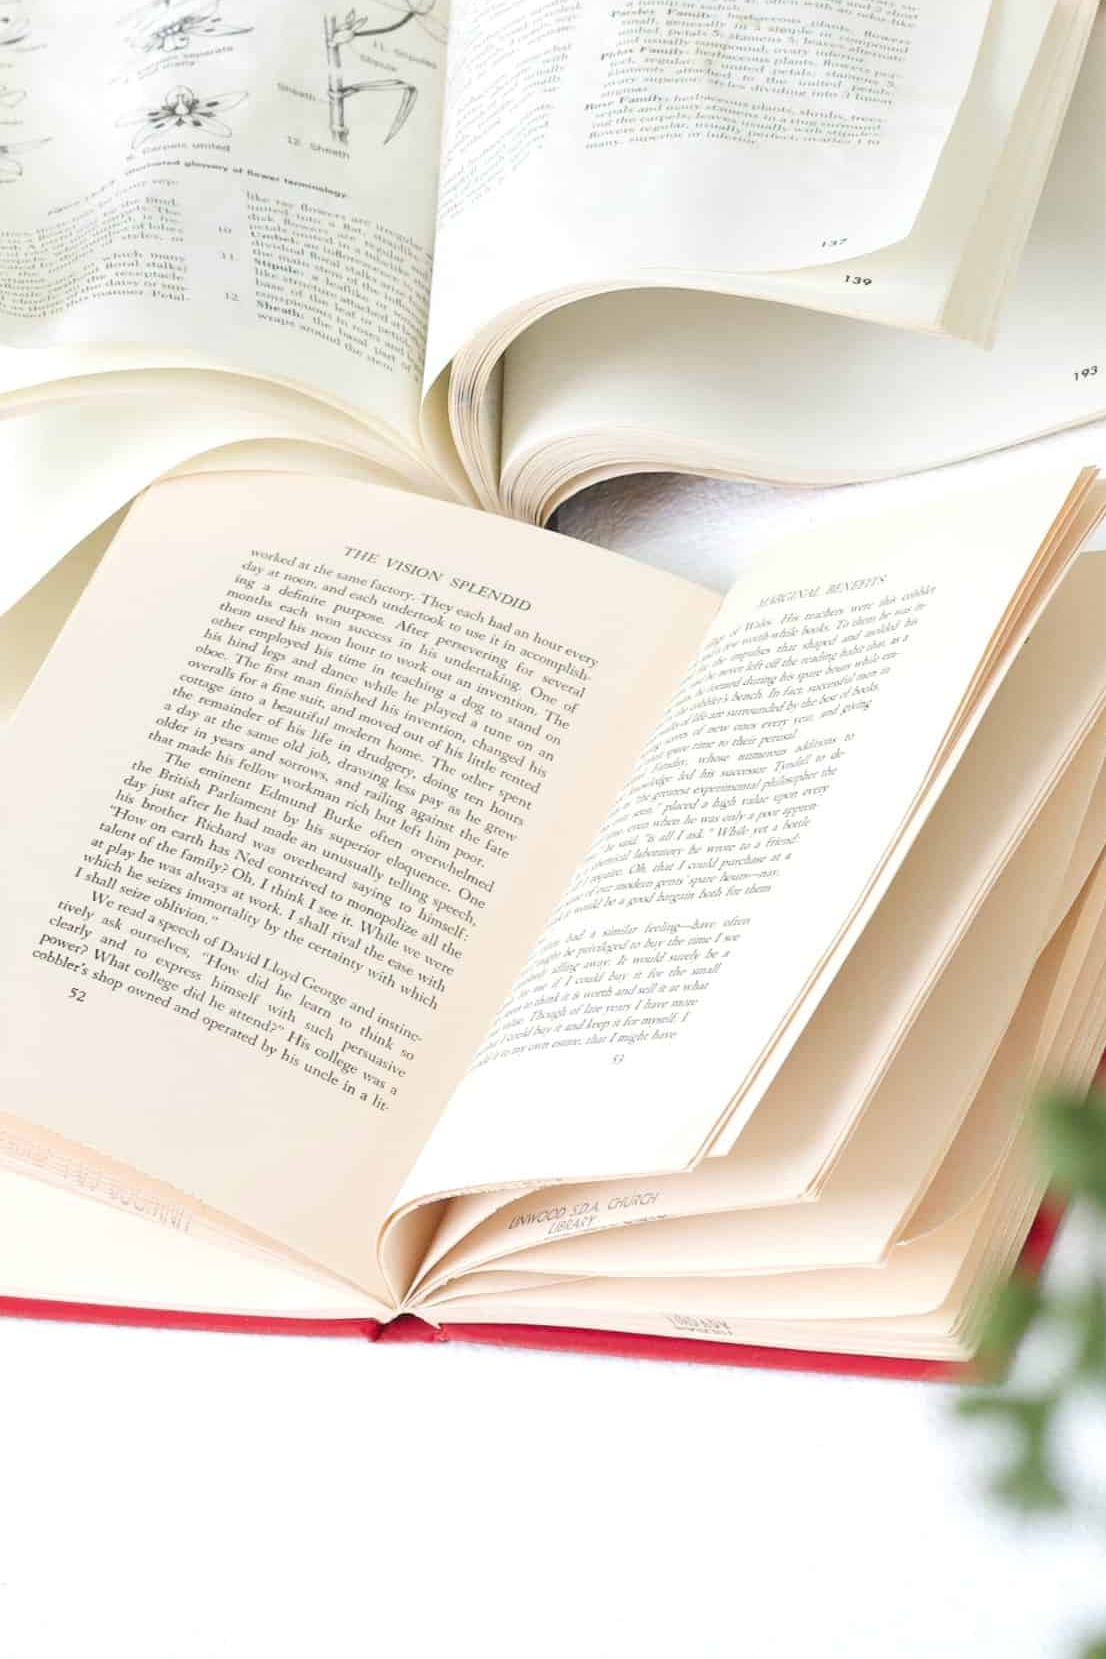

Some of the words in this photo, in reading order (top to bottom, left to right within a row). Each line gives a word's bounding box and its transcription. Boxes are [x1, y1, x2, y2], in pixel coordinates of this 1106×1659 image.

[821, 238, 848, 248] 137
[844, 275, 872, 286] 139
[1072, 365, 1099, 381] 193
[343, 546, 378, 564] THE
[385, 557, 445, 582] VISION
[450, 577, 533, 613] SPLENDID
[91, 890, 115, 909] We
[117, 902, 147, 920] read
[147, 913, 155, 924] a
[158, 918, 201, 941] speech
[203, 936, 221, 948] of
[220, 940, 261, 966] David
[262, 957, 301, 984] Lloyd
[302, 976, 347, 1006] George
[349, 1001, 375, 1019] and
[376, 1013, 423, 1042] instinc-
[67, 986, 87, 1003] 52
[32, 948, 89, 976] cobbler's
[92, 970, 123, 991] shop
[127, 985, 172, 1009] owned
[173, 1003, 200, 1020] and
[202, 1016, 258, 1047] operated
[261, 1039, 277, 1057] by
[281, 1049, 300, 1067] his
[303, 1061, 340, 1085] uncle
[342, 1080, 356, 1095] in
[360, 1092, 368, 1101] a
[372, 1093, 390, 1111] lit-
[210, 976, 260, 1005] himself
[267, 1004, 296, 1023] with
[304, 1021, 335, 1041] such
[340, 1040, 406, 1078] persuasive
